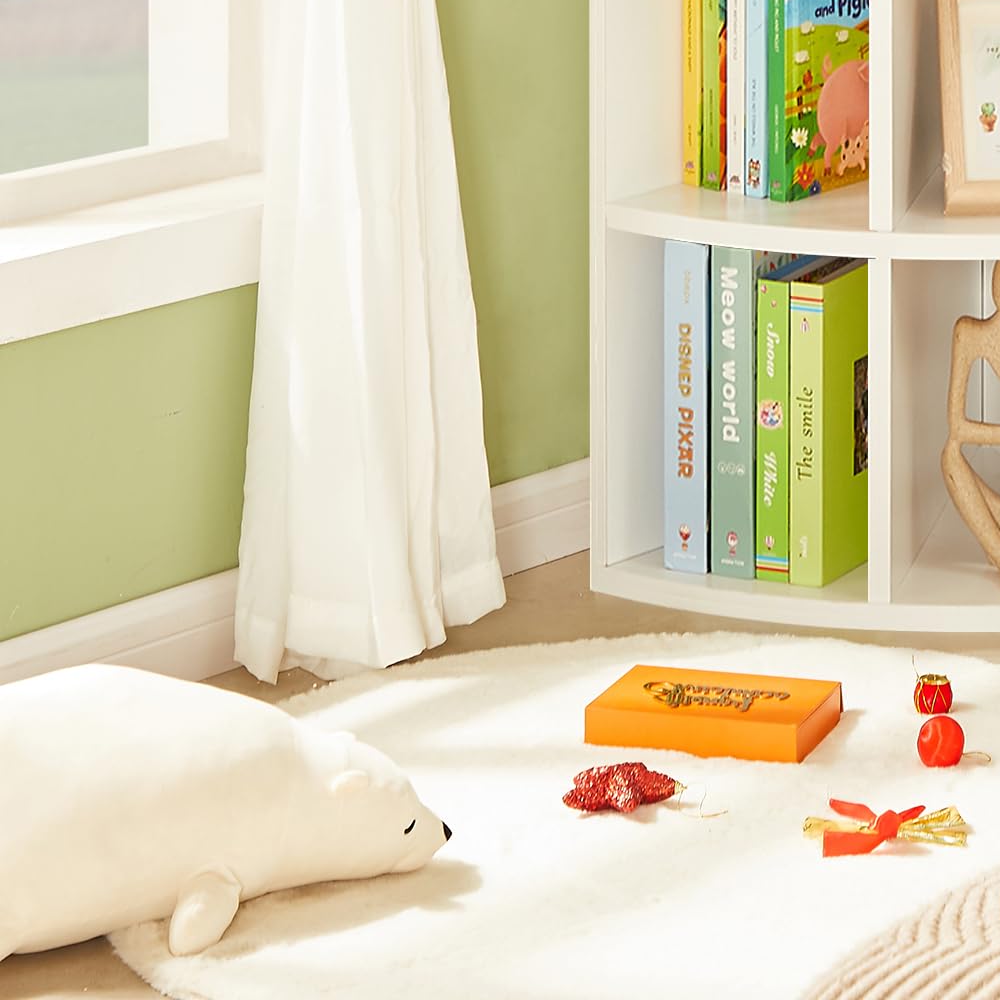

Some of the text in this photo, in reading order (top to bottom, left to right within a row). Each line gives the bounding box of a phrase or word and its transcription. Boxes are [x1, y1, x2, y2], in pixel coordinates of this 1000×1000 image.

[719, 266, 738, 350] Meow
[678, 406, 694, 479] PIXAR
[721, 360, 740, 443] world
[763, 322, 780, 507] Snow White
[797, 386, 814, 481] The smile
